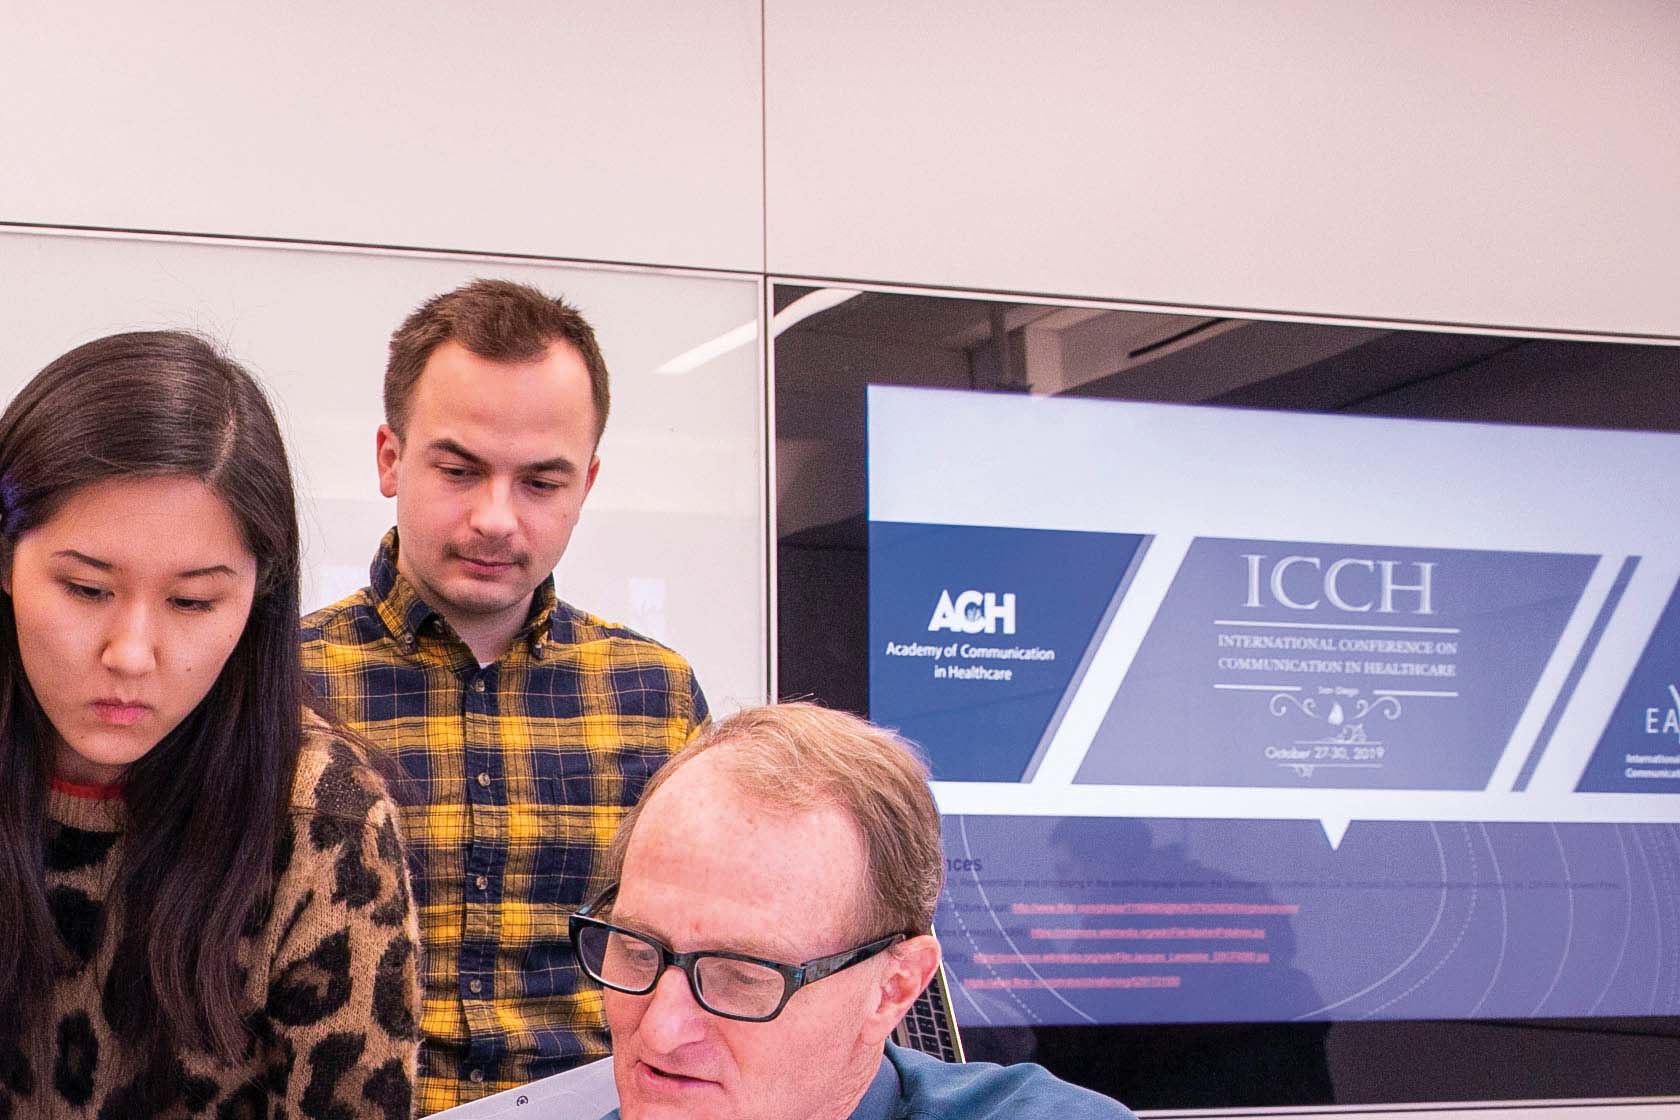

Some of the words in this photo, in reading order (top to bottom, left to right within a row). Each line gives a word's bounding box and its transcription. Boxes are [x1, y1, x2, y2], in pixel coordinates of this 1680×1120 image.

[1240, 553, 1438, 615] ICCH
[927, 589, 1016, 635] ACH
[886, 641, 943, 661] Academy
[944, 642, 958, 658] of
[960, 643, 1056, 661] Communication
[1219, 634, 1339, 652] INTERNATIONAL
[1340, 639, 1435, 654] CONFERENCE
[1438, 642, 1458, 655] ON
[934, 664, 947, 679] in
[948, 665, 1013, 681] Healthcare
[1219, 657, 1345, 675] COMMUNICATION
[1346, 660, 1361, 674] IN
[1364, 662, 1457, 678] HEALTHCARE
[1264, 746, 1311, 760] October
[1352, 746, 1385, 760] 2019
